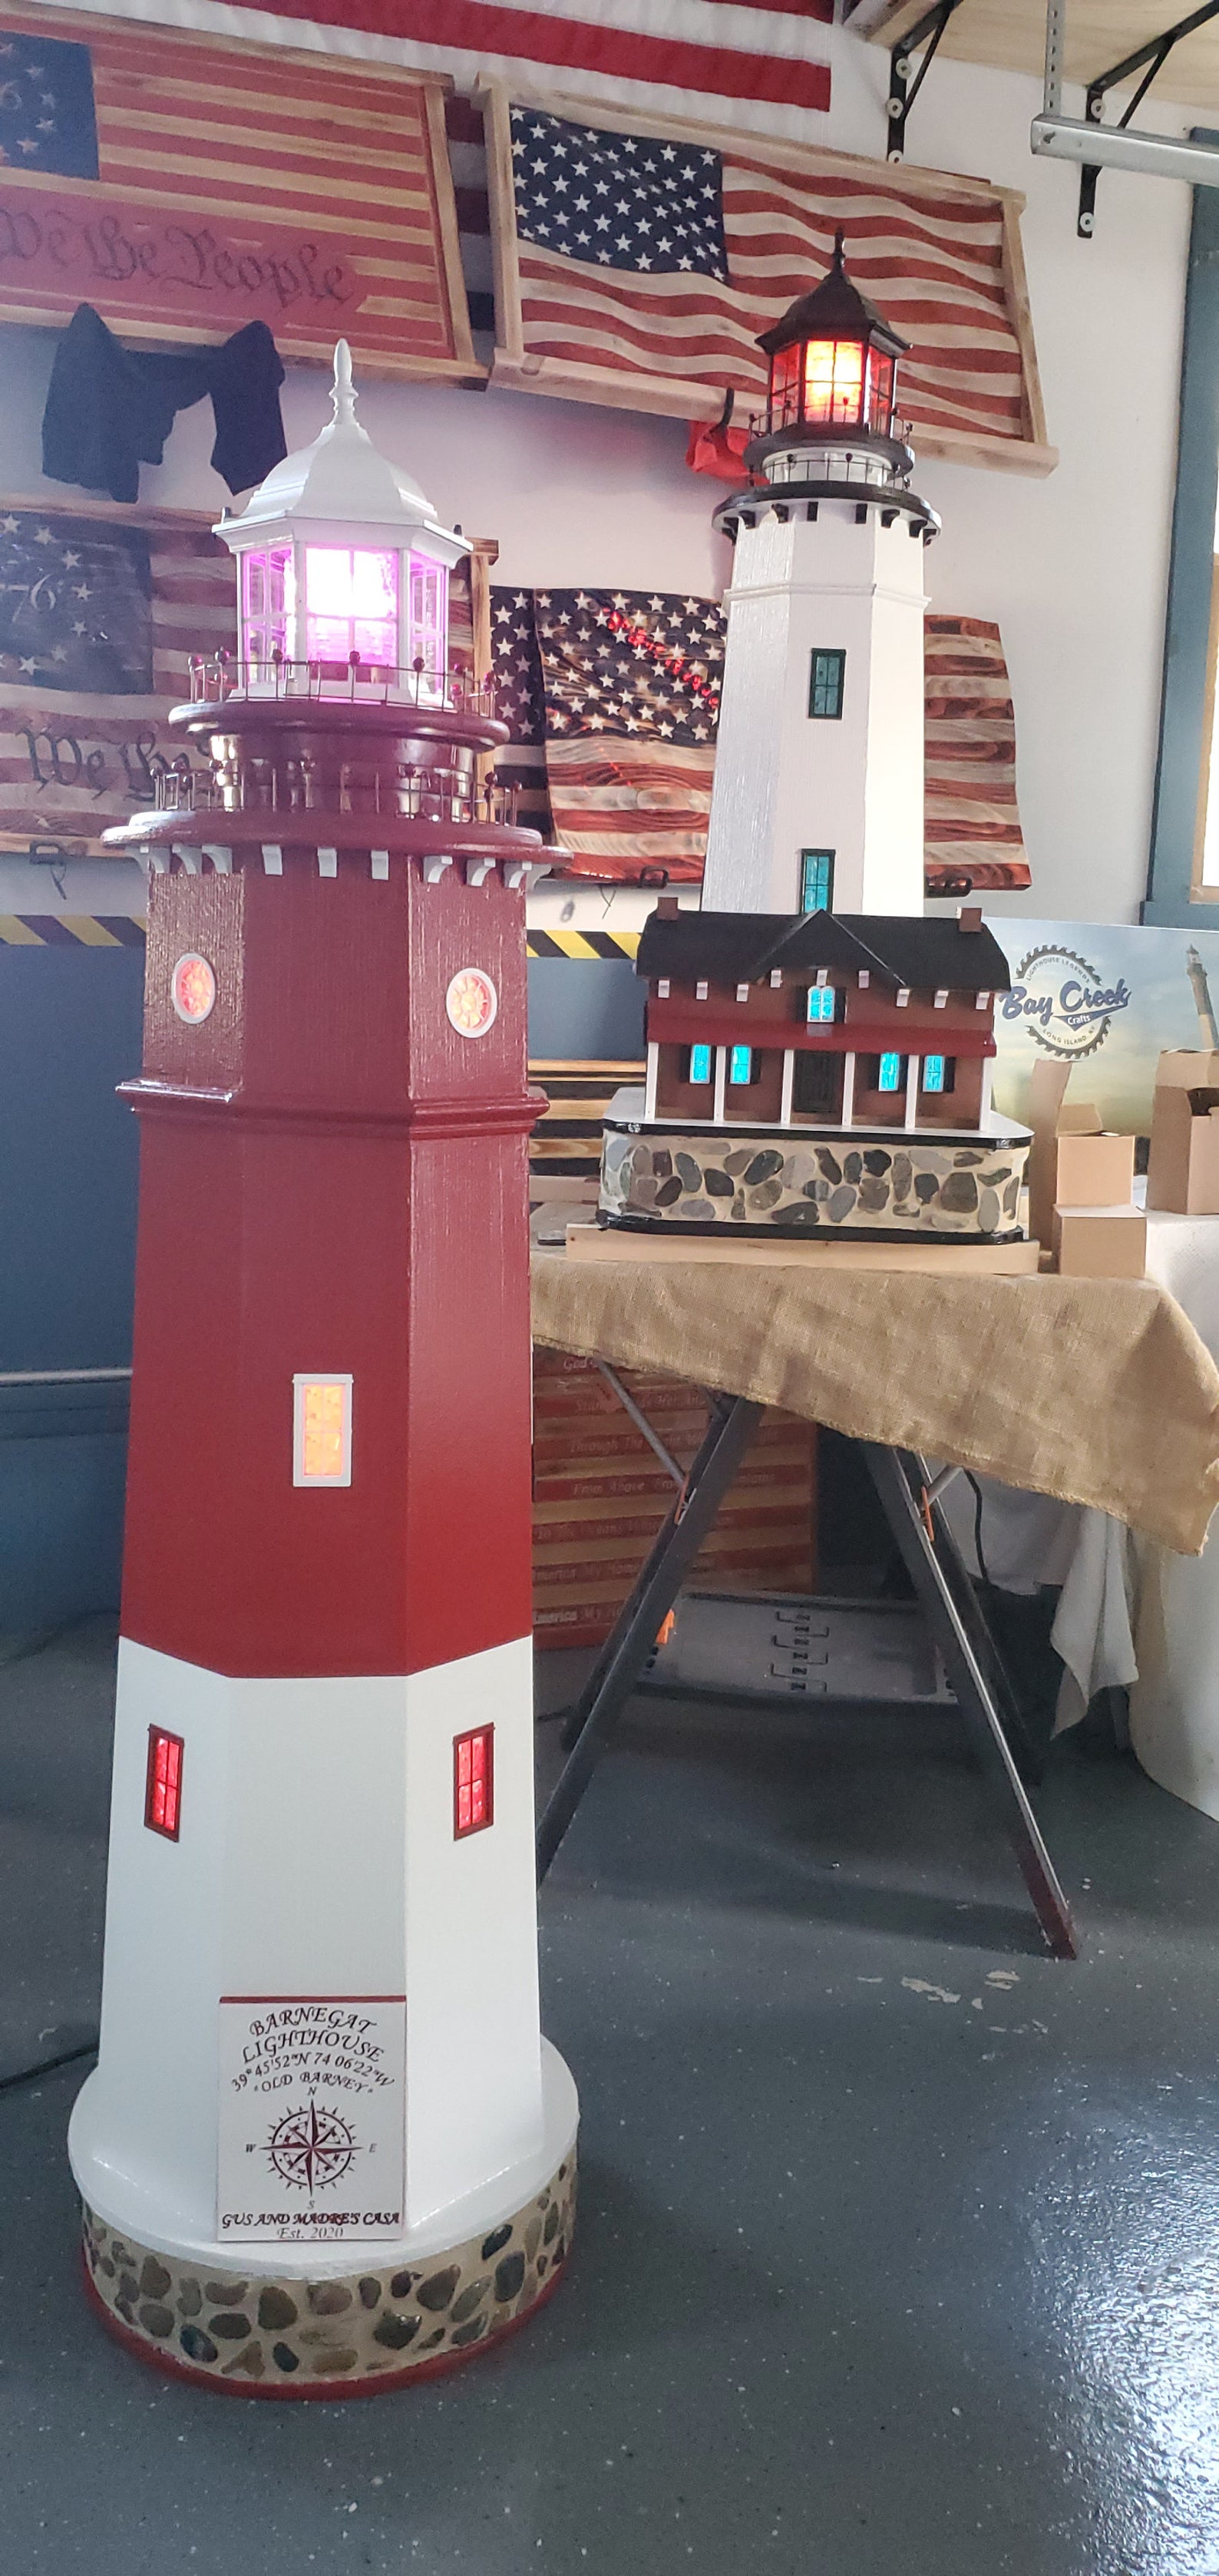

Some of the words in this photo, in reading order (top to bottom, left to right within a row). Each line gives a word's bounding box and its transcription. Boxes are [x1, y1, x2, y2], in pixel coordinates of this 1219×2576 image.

[159, 227, 353, 310] People
[15, 726, 109, 801] We
[1026, 957, 1060, 981] LIGHTHOUSE
[1062, 957, 1091, 984] LEGENDS
[999, 986, 1053, 1027] Bay
[1060, 978, 1132, 1013] Creek
[1067, 1014, 1091, 1026] Crafts
[1043, 1029, 1061, 1043] LONG
[249, 2006, 378, 2037] BARNEGAT
[242, 2028, 385, 2064] LIGHTHOUSE
[314, 2052, 331, 2065] 74
[307, 2086, 318, 2096] N
[245, 2143, 257, 2153] W
[368, 2143, 378, 2153] E
[307, 2200, 315, 2210] S
[222, 2212, 253, 2229] GUS
[254, 2212, 291, 2226] AND
[292, 2212, 362, 2226] MADRE'S
[363, 2211, 400, 2226] CASA
[276, 2227, 305, 2240] Est.
[310, 2227, 344, 2240] 2020
